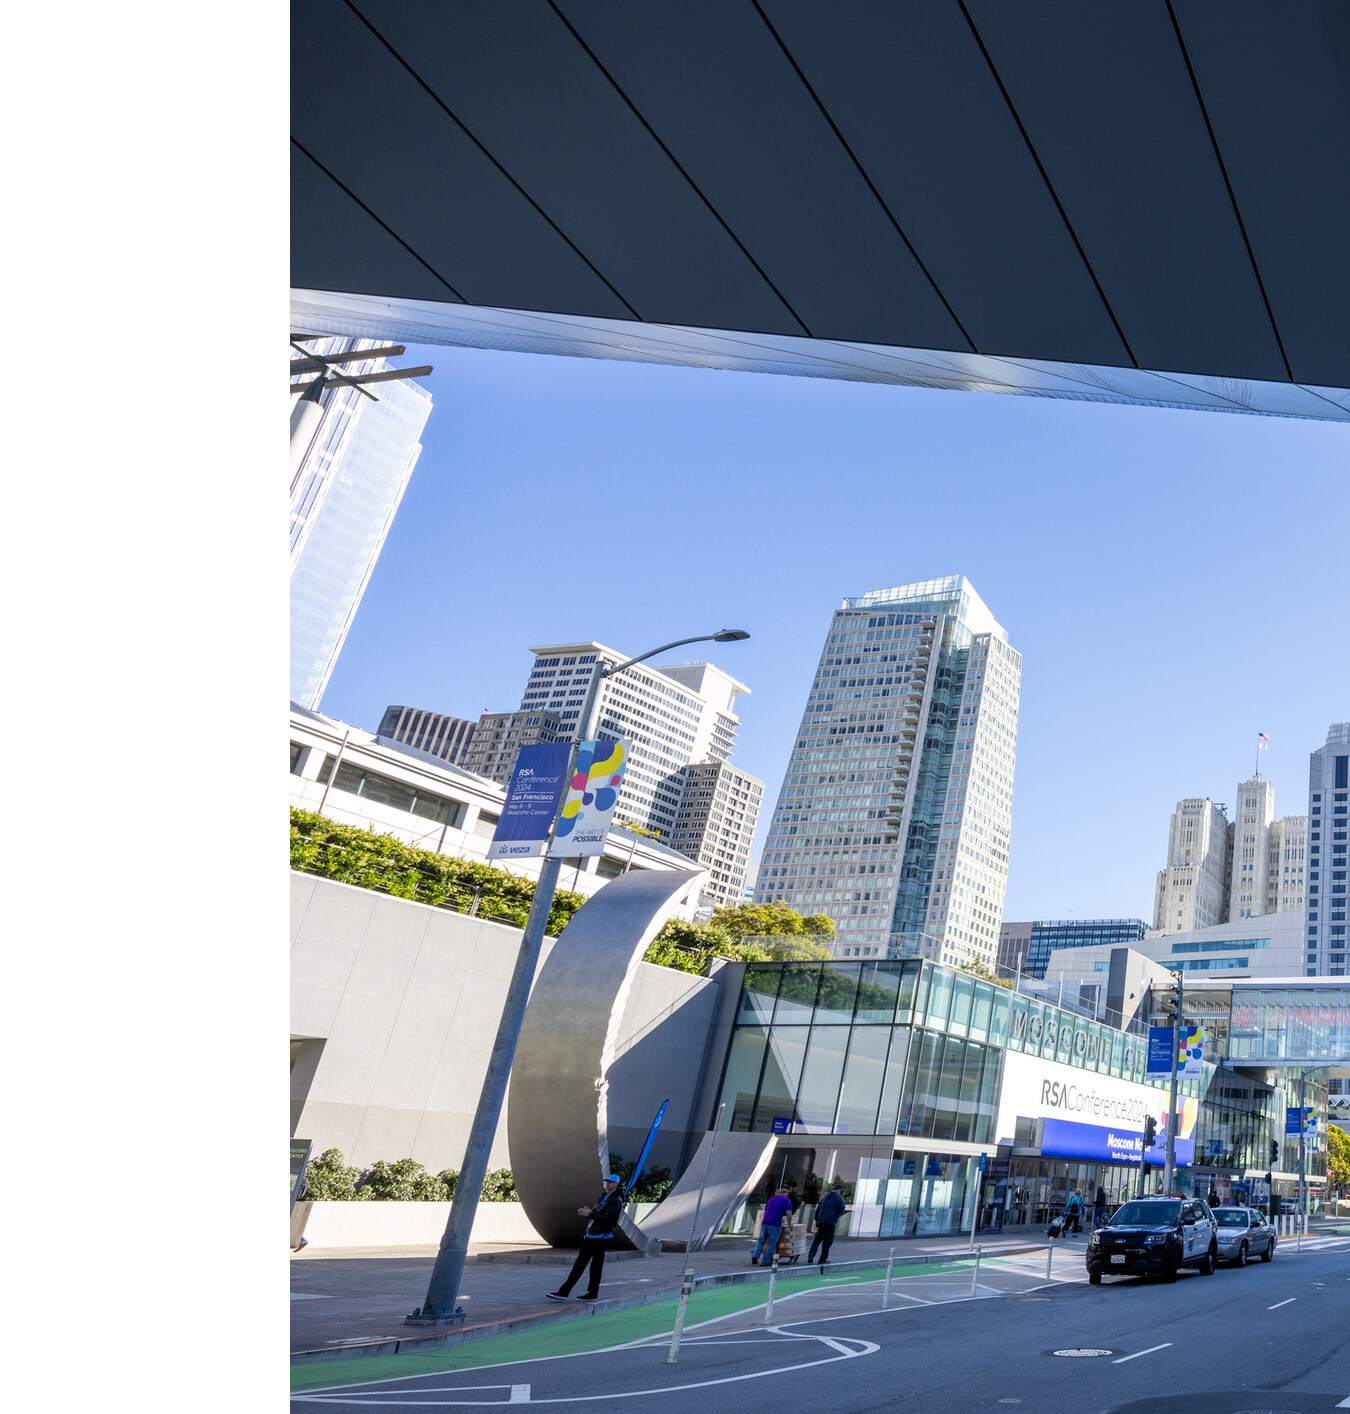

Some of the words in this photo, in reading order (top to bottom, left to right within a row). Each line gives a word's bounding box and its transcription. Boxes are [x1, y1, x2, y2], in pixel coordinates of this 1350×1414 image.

[518, 768, 534, 776] RSA
[514, 783, 531, 792] 2024
[1011, 1008, 1112, 1063] MOSCONE
[1107, 1133, 1134, 1151] Moscone
